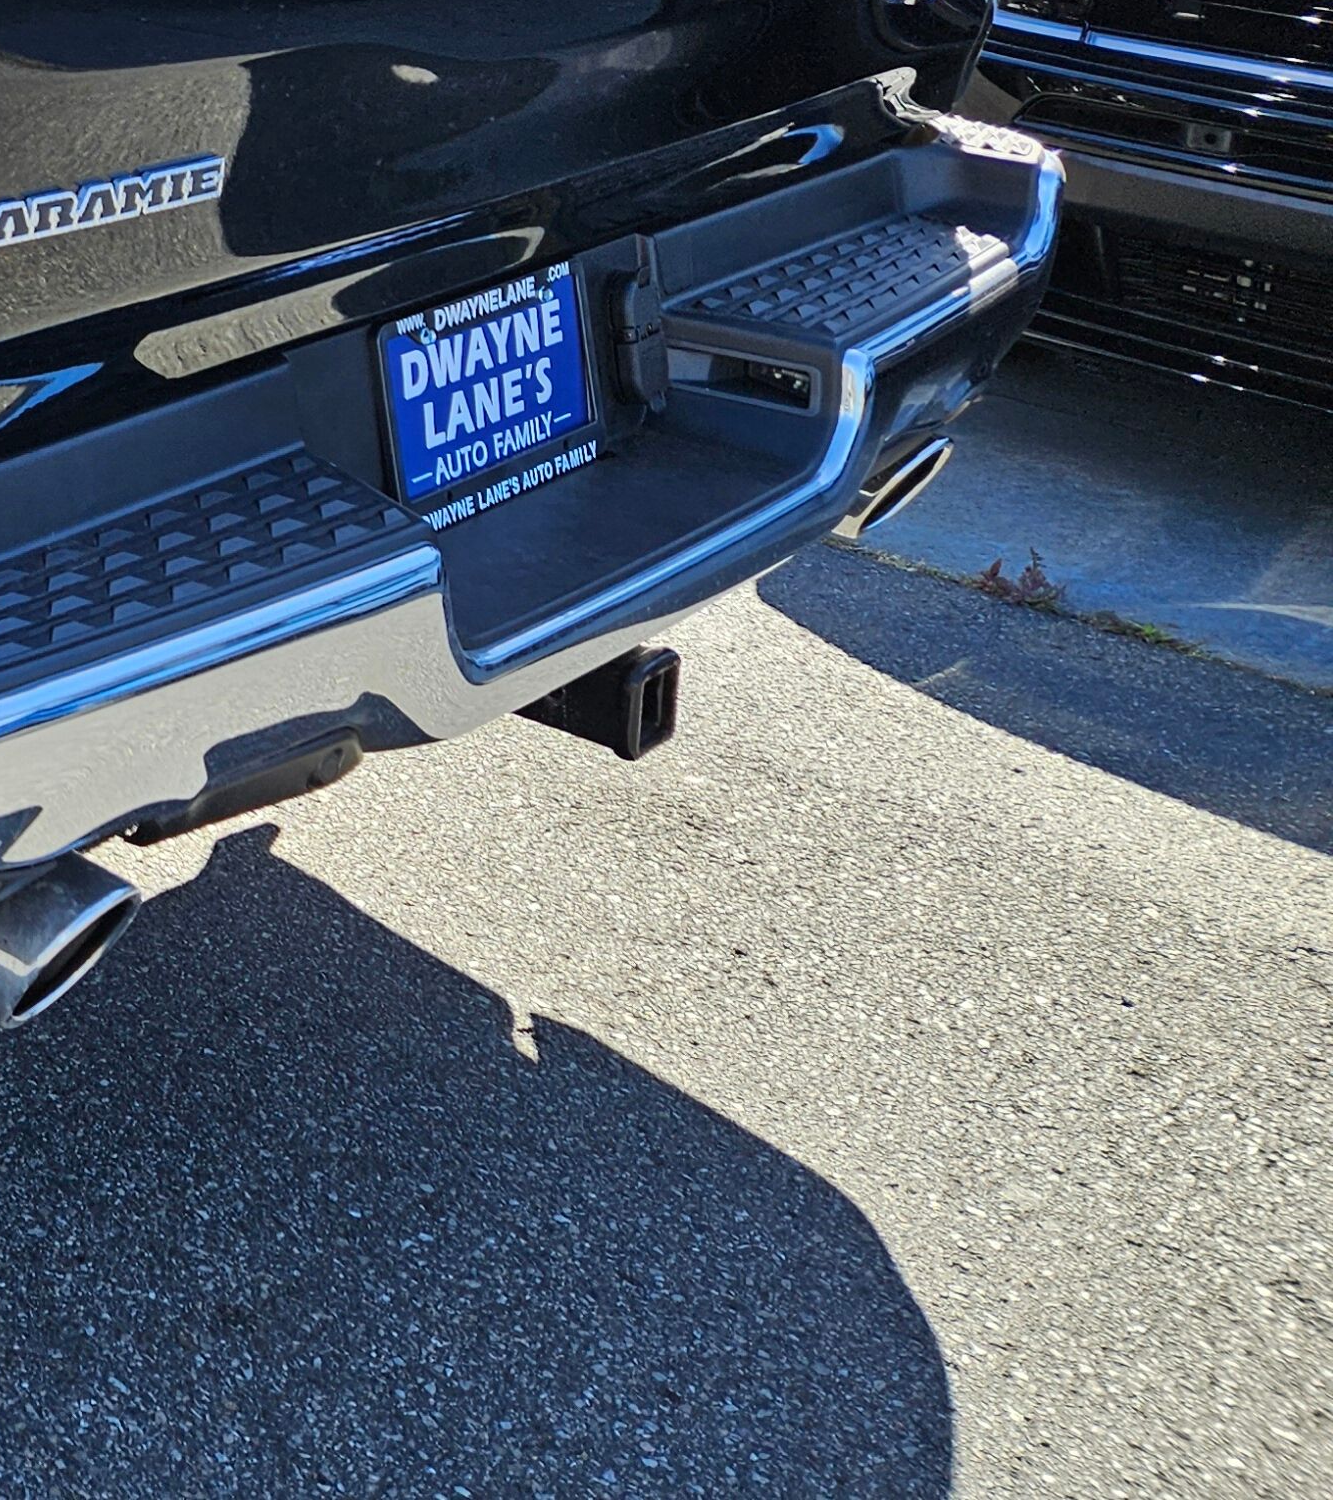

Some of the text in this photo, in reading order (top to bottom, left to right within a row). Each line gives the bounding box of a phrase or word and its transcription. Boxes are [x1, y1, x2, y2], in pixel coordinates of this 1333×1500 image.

[434, 276, 536, 332] DWAYNELANE
[400, 299, 563, 400] DWAYNE
[423, 357, 552, 450] LANE'S
[435, 411, 552, 486] AUTO FAMILY
[478, 476, 521, 511] LANE'S
[522, 461, 554, 491] AUTO
[554, 440, 597, 475] FAMILY
